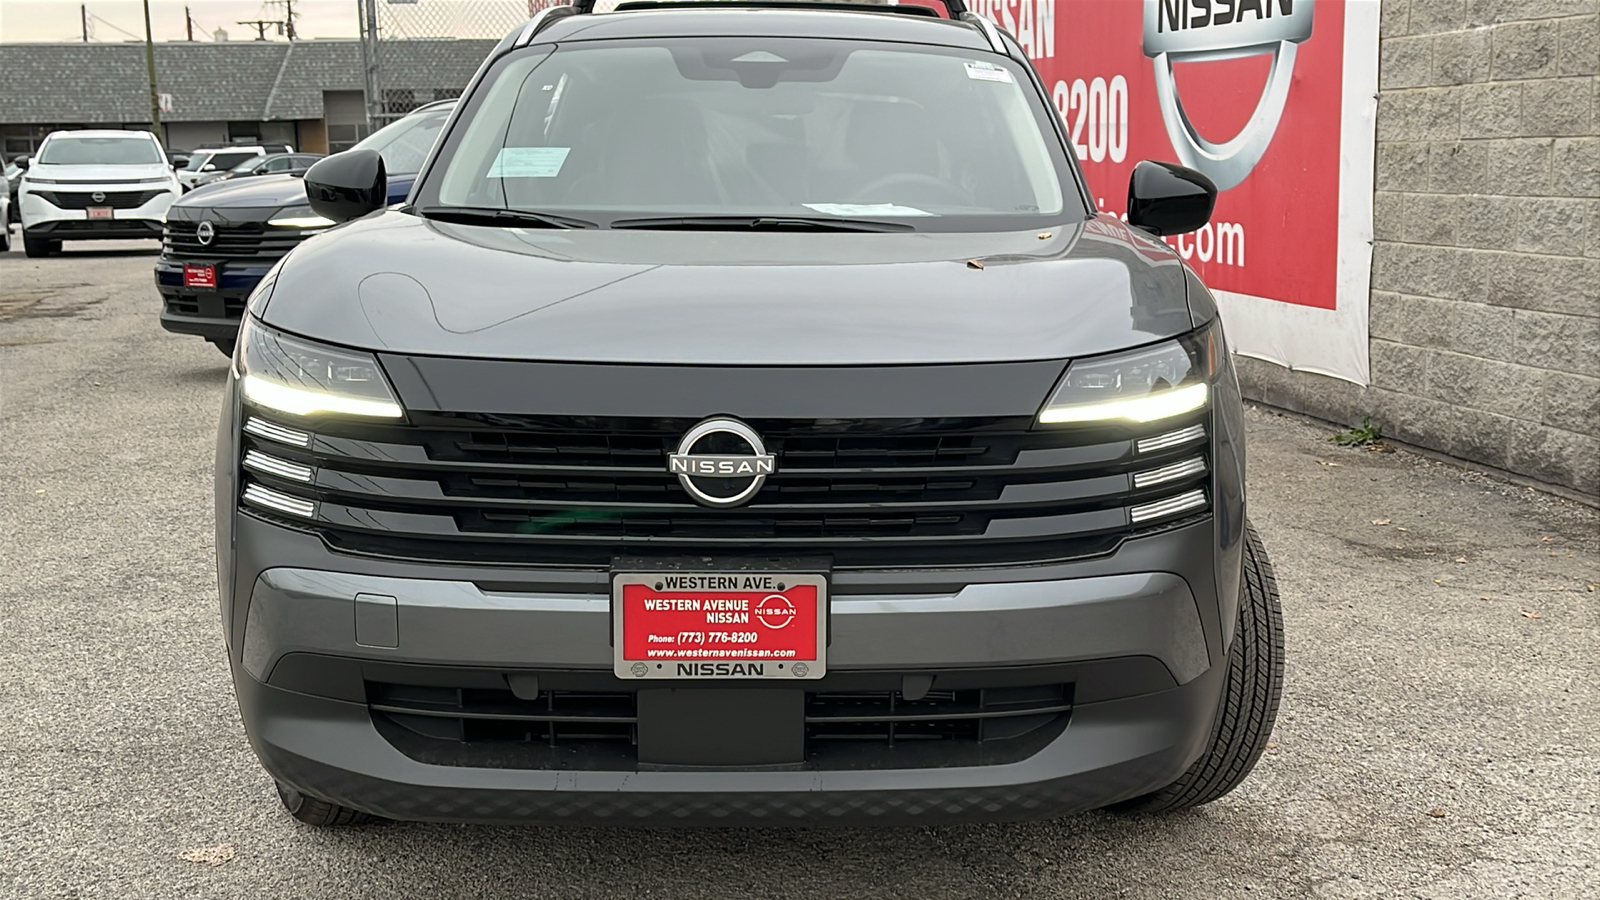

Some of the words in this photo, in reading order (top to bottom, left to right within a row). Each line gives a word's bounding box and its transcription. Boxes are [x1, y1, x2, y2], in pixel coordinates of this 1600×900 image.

[966, 0, 1055, 59] SAN
[671, 458, 773, 474] NISSAN
[664, 576, 738, 589] WESTERN
[743, 576, 776, 590] AVE.
[644, 599, 701, 611] WESTERN
[702, 599, 749, 611] AVENUE
[754, 608, 797, 616] NISSAN
[706, 612, 749, 624] NISSAN
[648, 634, 675, 643] Phone:
[677, 631, 705, 646] (773)
[708, 632, 758, 643] 776-8200
[647, 647, 796, 658] www.westernavenissan.com
[677, 663, 764, 677] NISSAN
